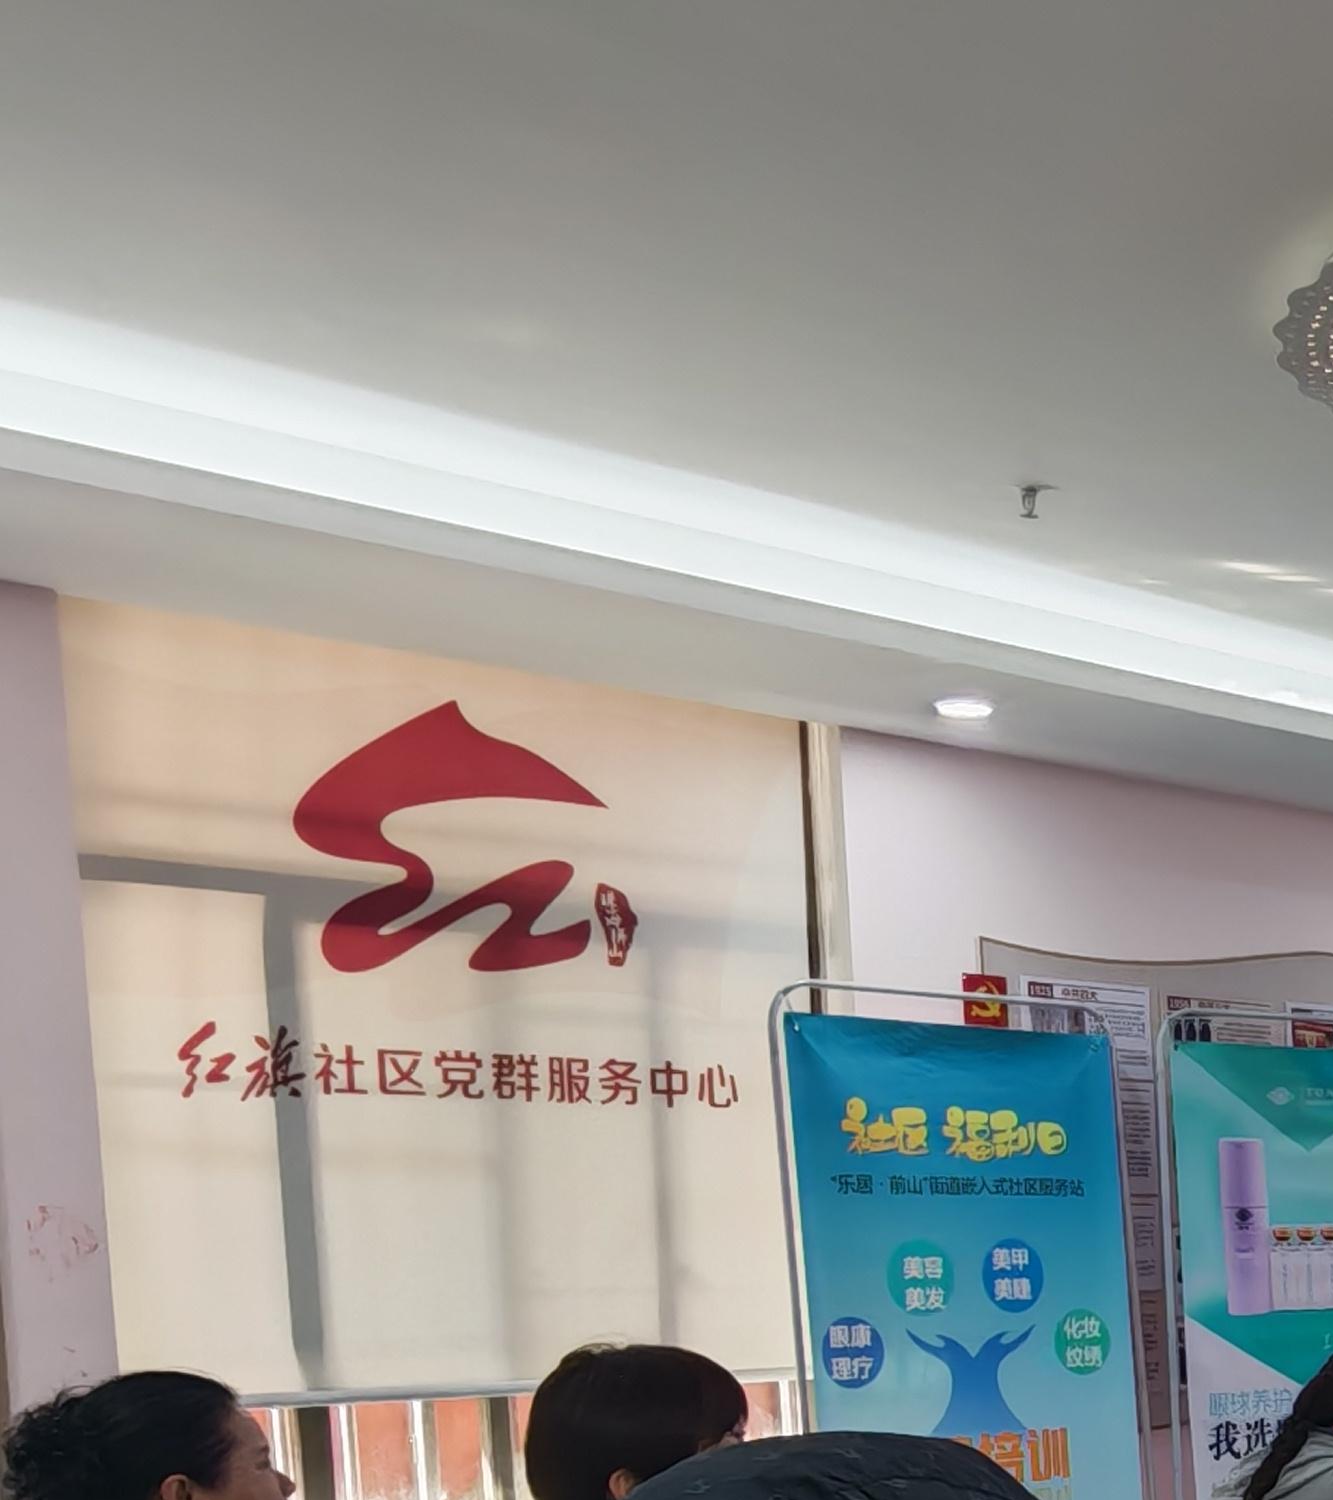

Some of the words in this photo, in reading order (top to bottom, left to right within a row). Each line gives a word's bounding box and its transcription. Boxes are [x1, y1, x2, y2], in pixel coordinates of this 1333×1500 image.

[177, 1021, 739, 1109] 红旗社区党群服务中心
[841, 1096, 930, 1156] 社区
[942, 1105, 1067, 1163] 福利日
[991, 1247, 1030, 1271] 美甲
[905, 1286, 946, 1312] 美发
[1064, 1316, 1101, 1339] 化妆
[831, 1356, 874, 1381] 理疗
[951, 1427, 1071, 1483] 培训
[1207, 1417, 1285, 1461] 我选
